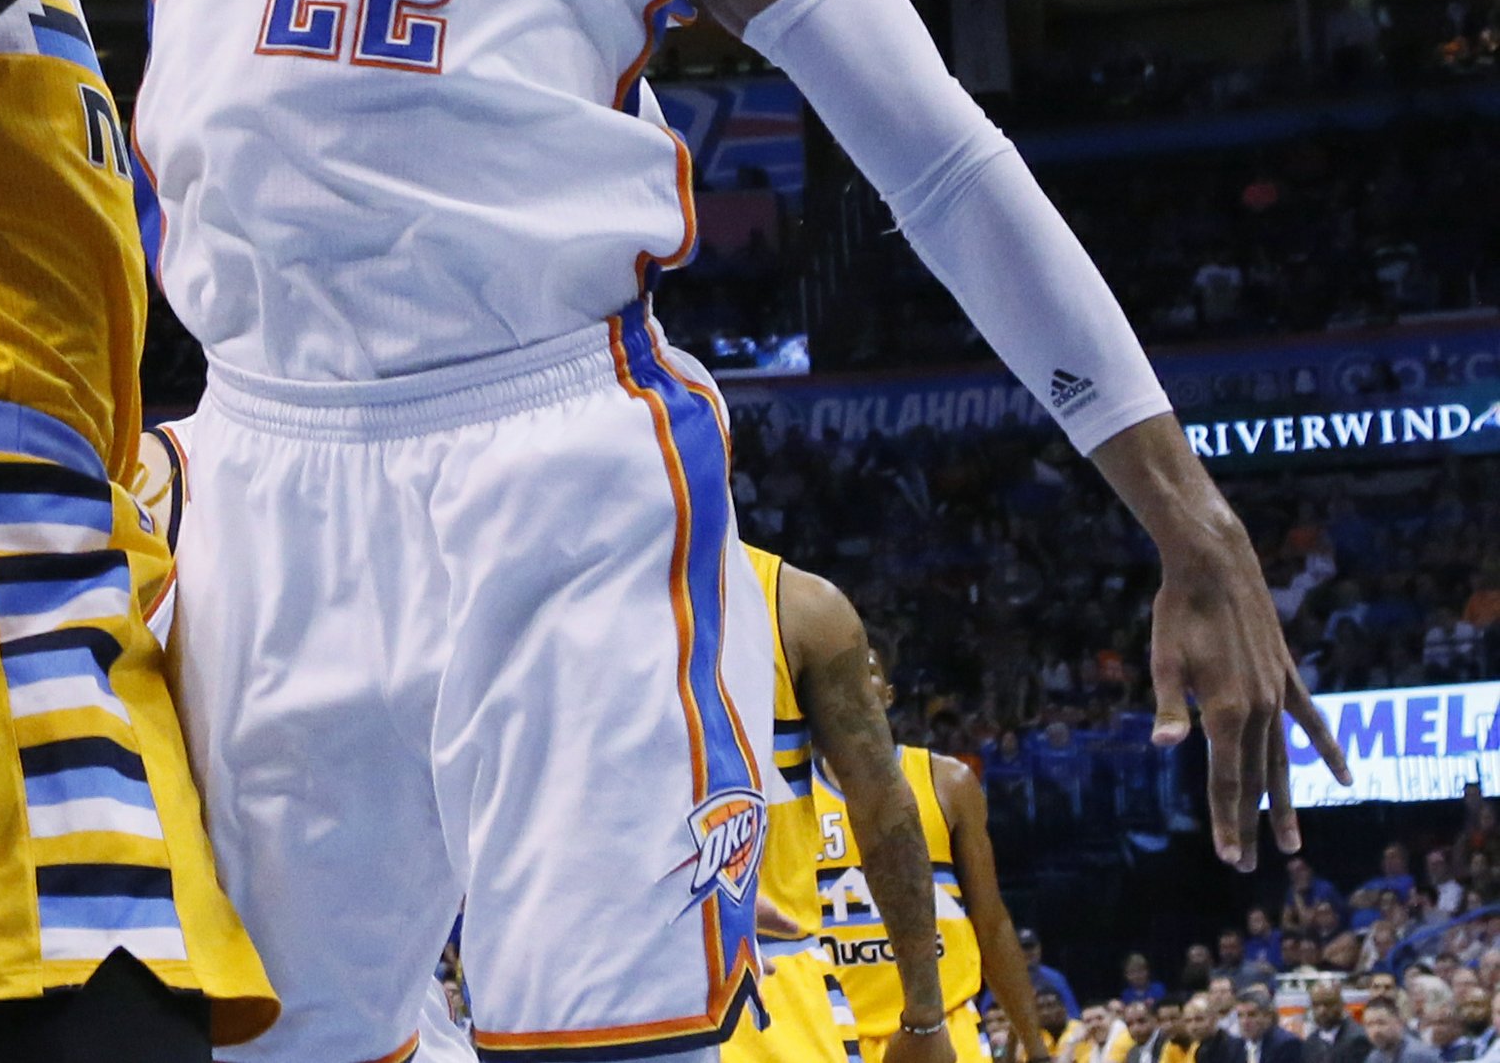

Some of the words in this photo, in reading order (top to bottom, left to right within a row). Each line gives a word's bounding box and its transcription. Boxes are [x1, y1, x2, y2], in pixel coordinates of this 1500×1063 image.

[1052, 378, 1093, 408] adidas
[1185, 403, 1472, 457] RIVERWIND
[816, 812, 846, 861] 5
